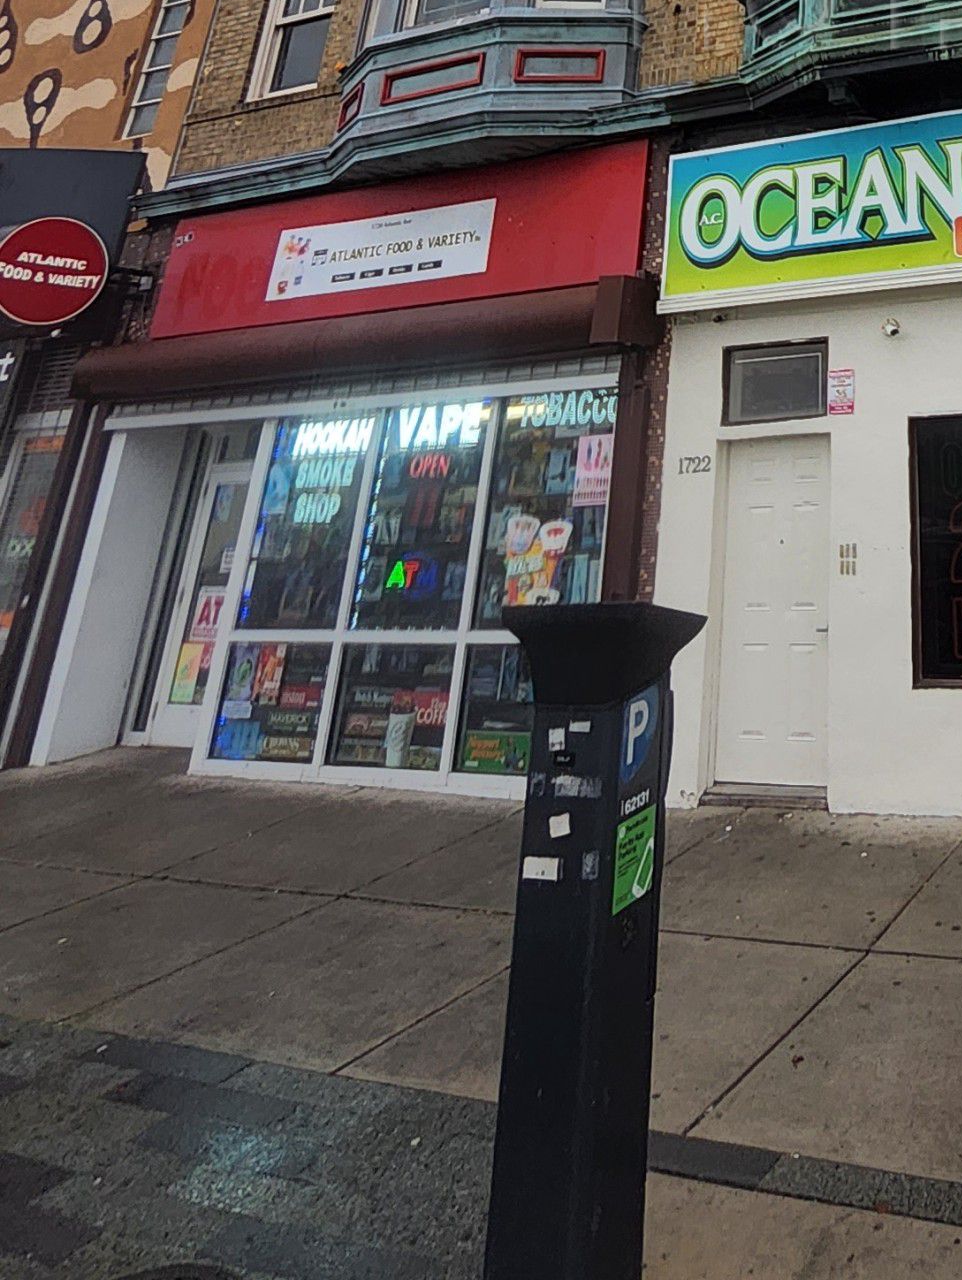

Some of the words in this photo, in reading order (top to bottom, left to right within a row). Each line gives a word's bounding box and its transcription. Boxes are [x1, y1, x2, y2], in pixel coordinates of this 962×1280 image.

[17, 251, 88, 271] ATLANTIC
[329, 244, 383, 263] ATLANTIC
[386, 240, 413, 256] FOOD
[416, 238, 424, 251] &
[428, 230, 477, 249] VARIETY
[34, 271, 45, 284] &
[48, 273, 102, 290] VARIETY
[293, 417, 376, 457] HOOKAH
[400, 401, 484, 448] VAPE
[295, 458, 357, 489] SMOKE
[409, 451, 450, 480] OPEN
[679, 455, 711, 475] 1722
[293, 492, 342, 525] SHOP
[386, 558, 439, 591] ATM
